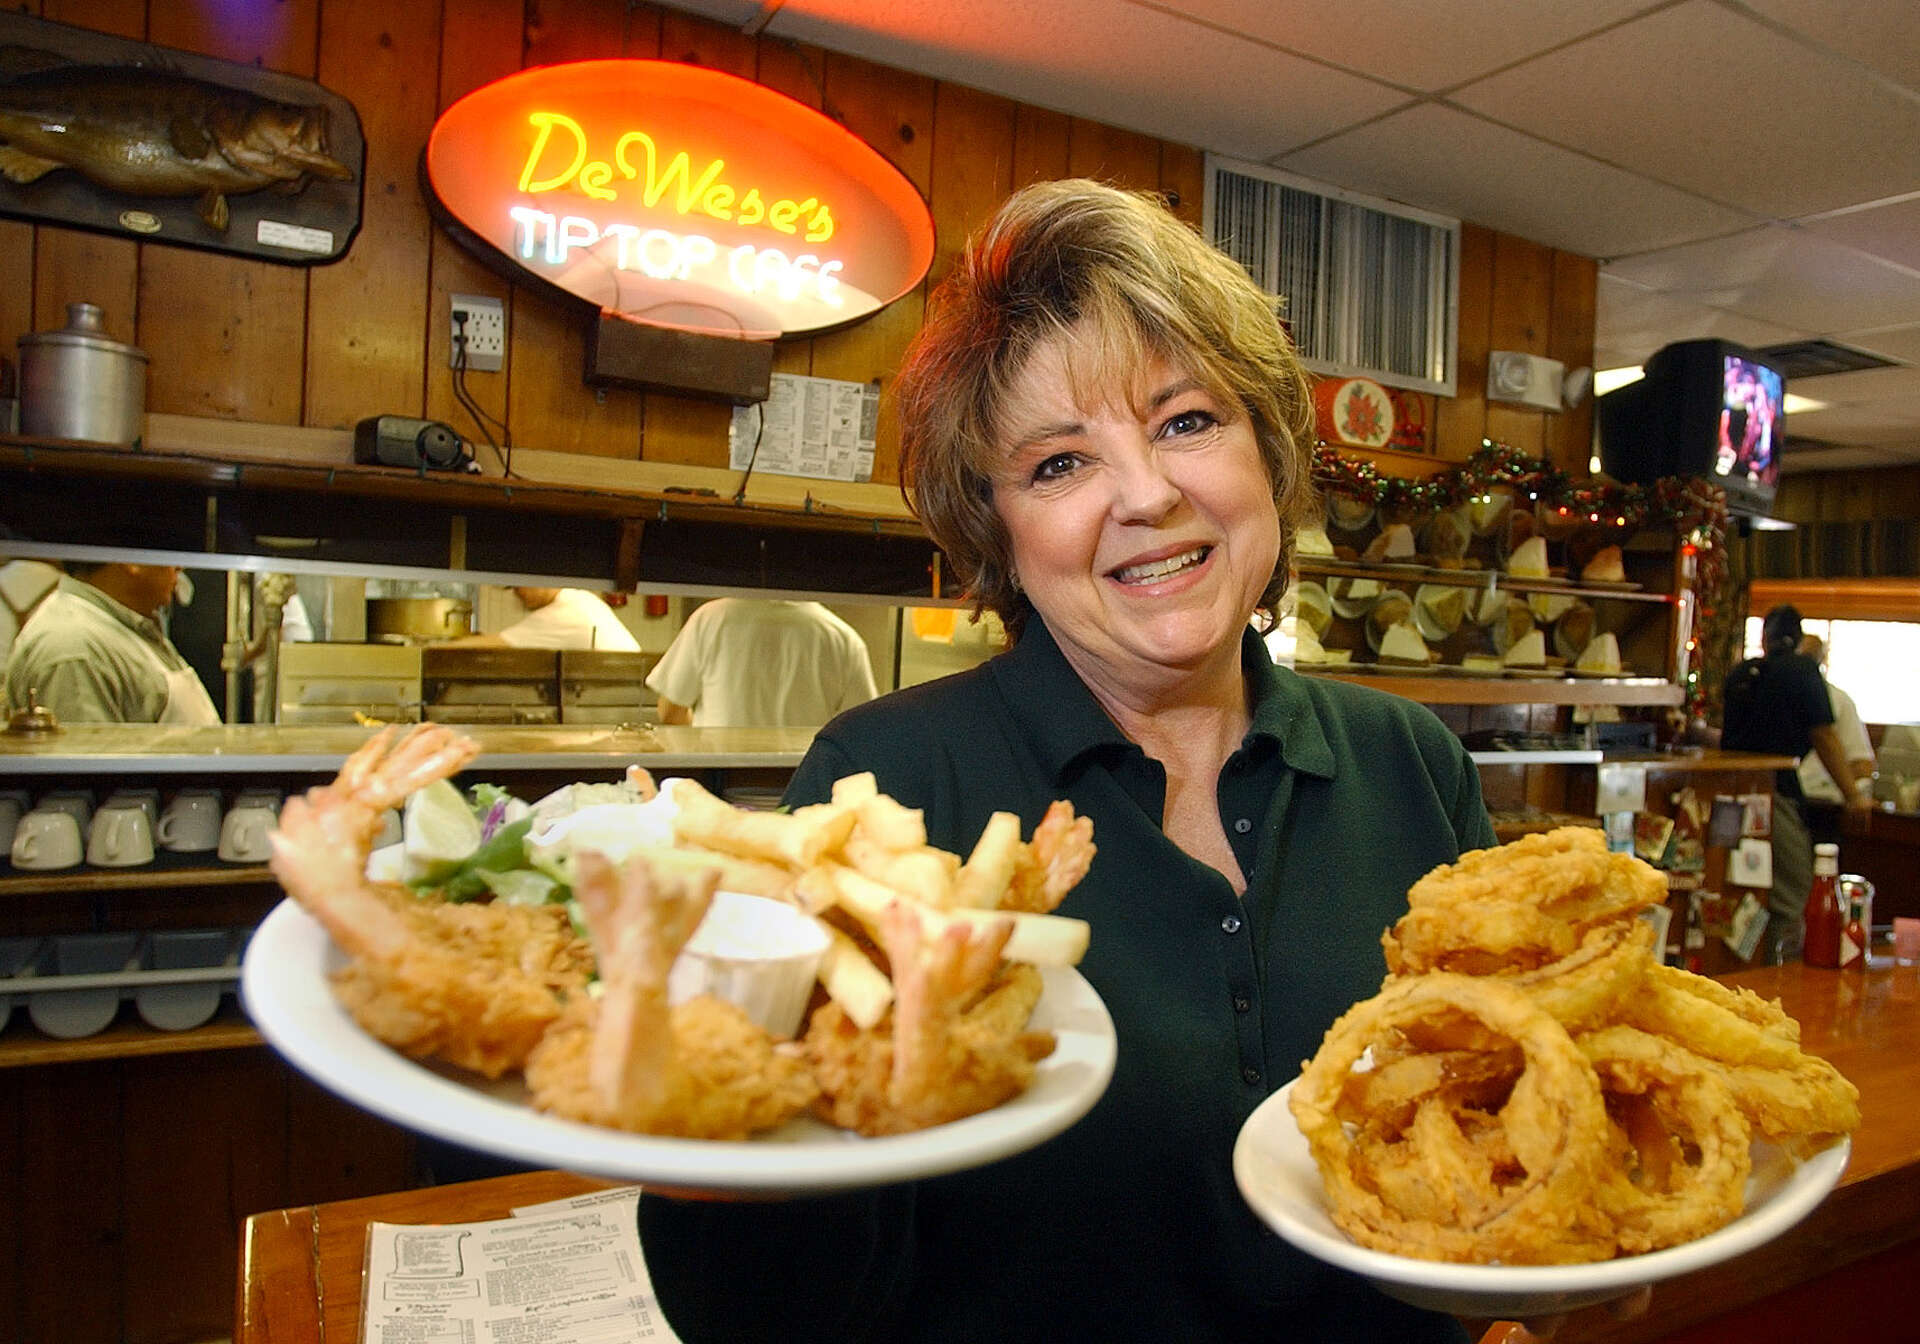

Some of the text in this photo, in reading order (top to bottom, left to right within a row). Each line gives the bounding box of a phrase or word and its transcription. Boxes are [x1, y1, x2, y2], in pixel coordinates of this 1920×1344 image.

[509, 205, 845, 308] TIP TOP CAFE
